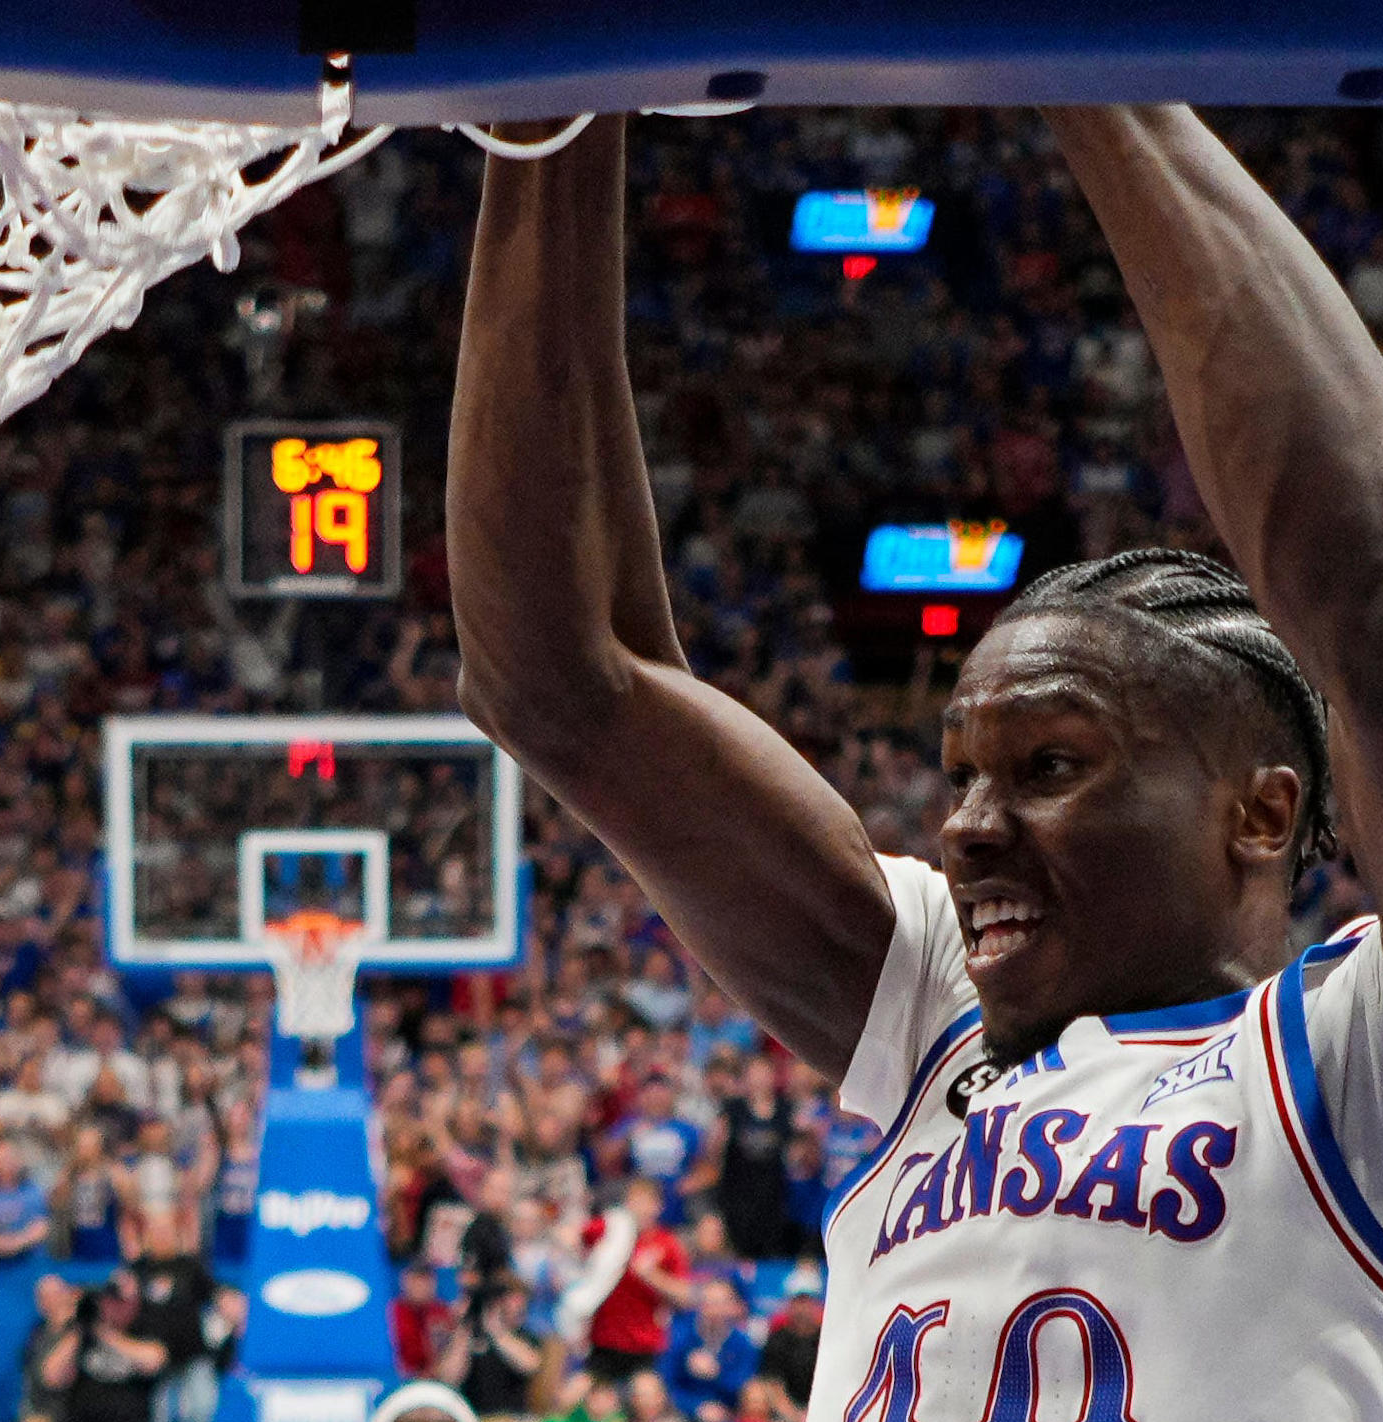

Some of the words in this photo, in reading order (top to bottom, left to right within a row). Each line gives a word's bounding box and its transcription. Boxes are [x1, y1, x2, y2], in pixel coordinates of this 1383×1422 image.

[272, 438, 383, 494] 6:46
[290, 488, 369, 575] 19
[957, 1063, 1003, 1099] S
